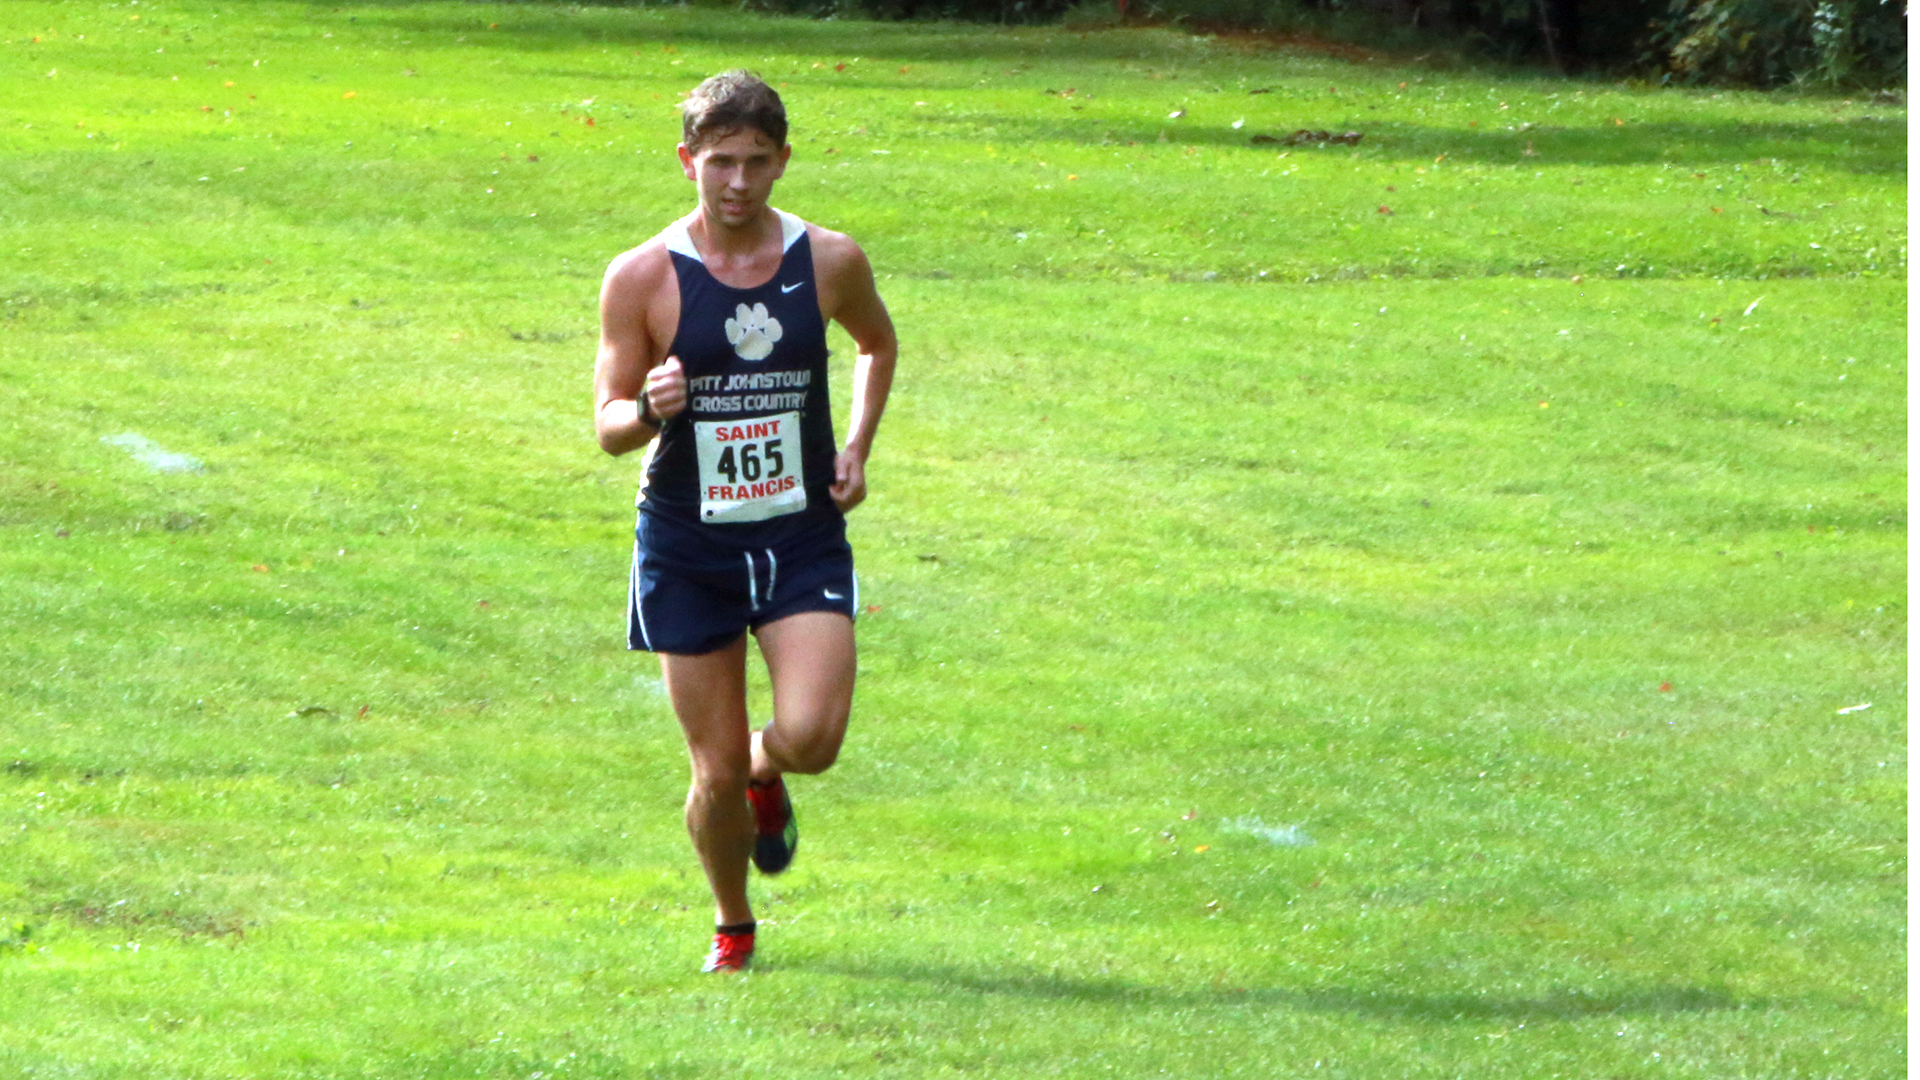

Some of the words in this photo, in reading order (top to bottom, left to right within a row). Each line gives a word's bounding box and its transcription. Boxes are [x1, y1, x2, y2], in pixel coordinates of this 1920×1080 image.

[690, 375, 722, 393] PITT
[692, 395, 742, 412] CROSS
[743, 391, 808, 411] COUNTRY
[715, 420, 781, 442] SAINT
[717, 439, 784, 484] 465
[708, 476, 796, 500] FRANCIS
